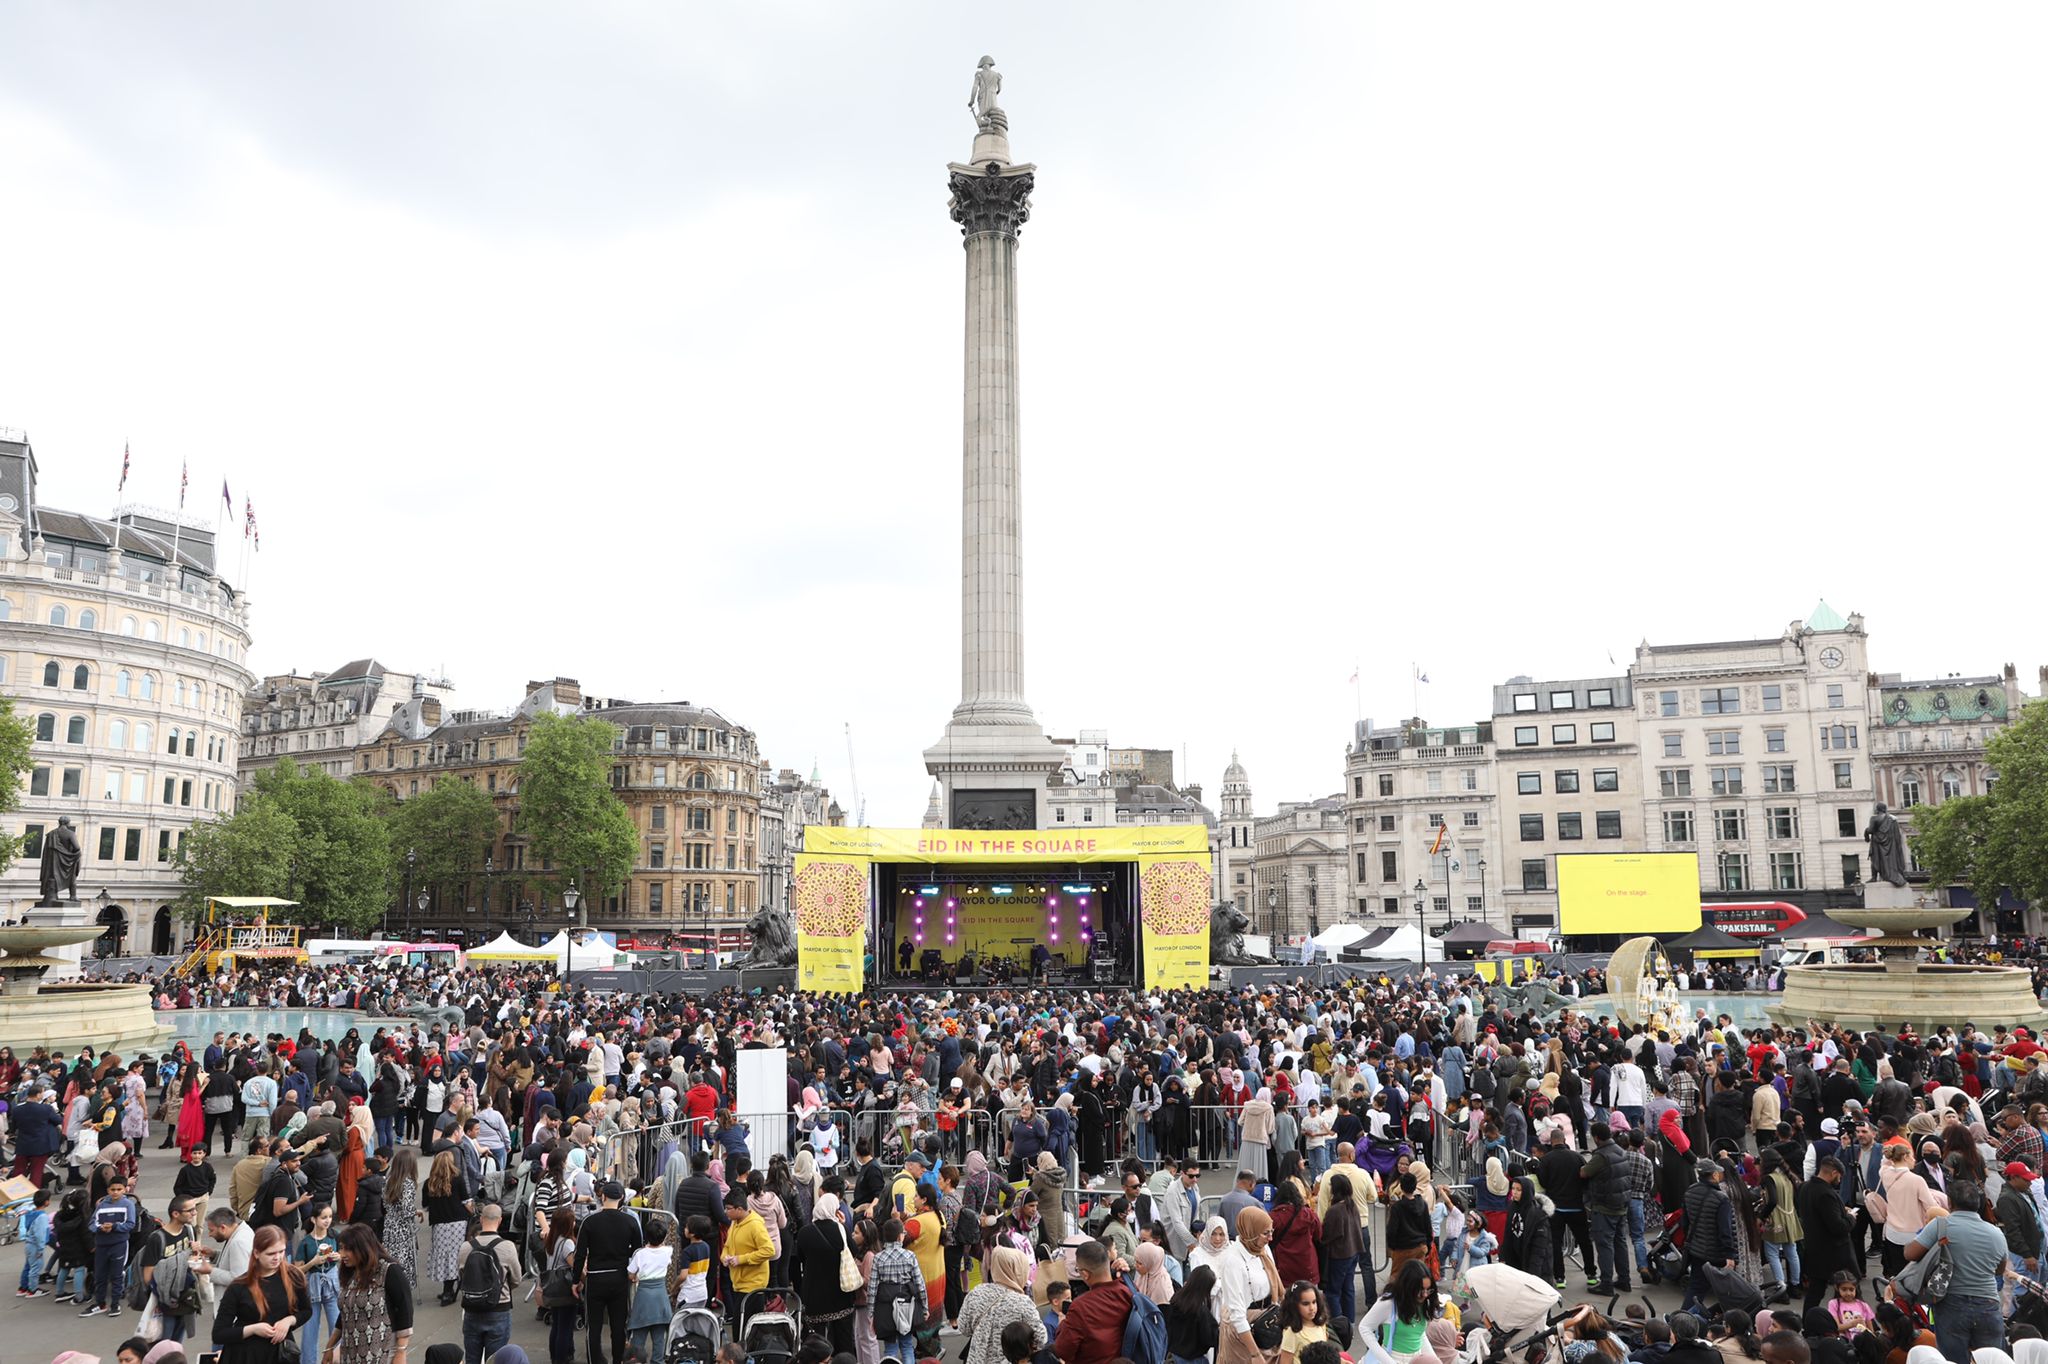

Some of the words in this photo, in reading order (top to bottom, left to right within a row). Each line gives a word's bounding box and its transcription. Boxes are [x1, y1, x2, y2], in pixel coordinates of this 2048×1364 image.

[917, 839, 947, 853] EID
[955, 840, 973, 853] IN
[980, 840, 1015, 853] THE
[1022, 839, 1096, 853] SQUARE
[952, 896, 985, 905] MAYOR
[987, 896, 1001, 905] OF
[1004, 896, 1047, 905] LONDON
[1714, 923, 1776, 933] GPAKISTAN.PK
